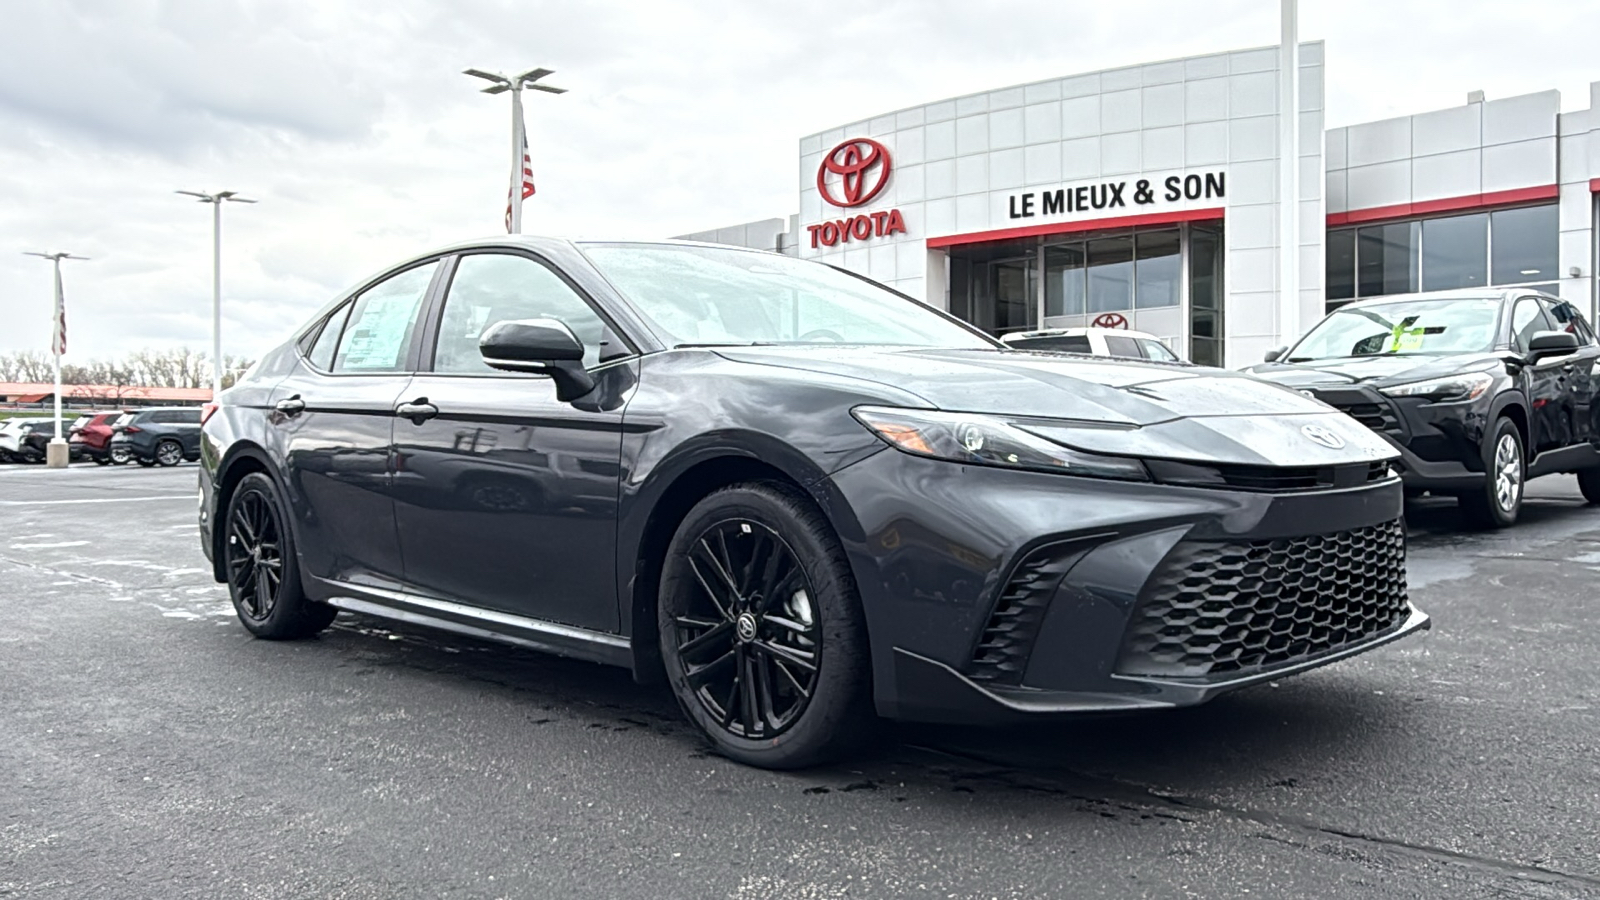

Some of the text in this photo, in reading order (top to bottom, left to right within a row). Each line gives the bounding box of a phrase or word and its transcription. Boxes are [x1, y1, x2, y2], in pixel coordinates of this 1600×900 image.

[1009, 171, 1225, 219] LE MIEUX & SON
[807, 209, 907, 248] TOYOTA
